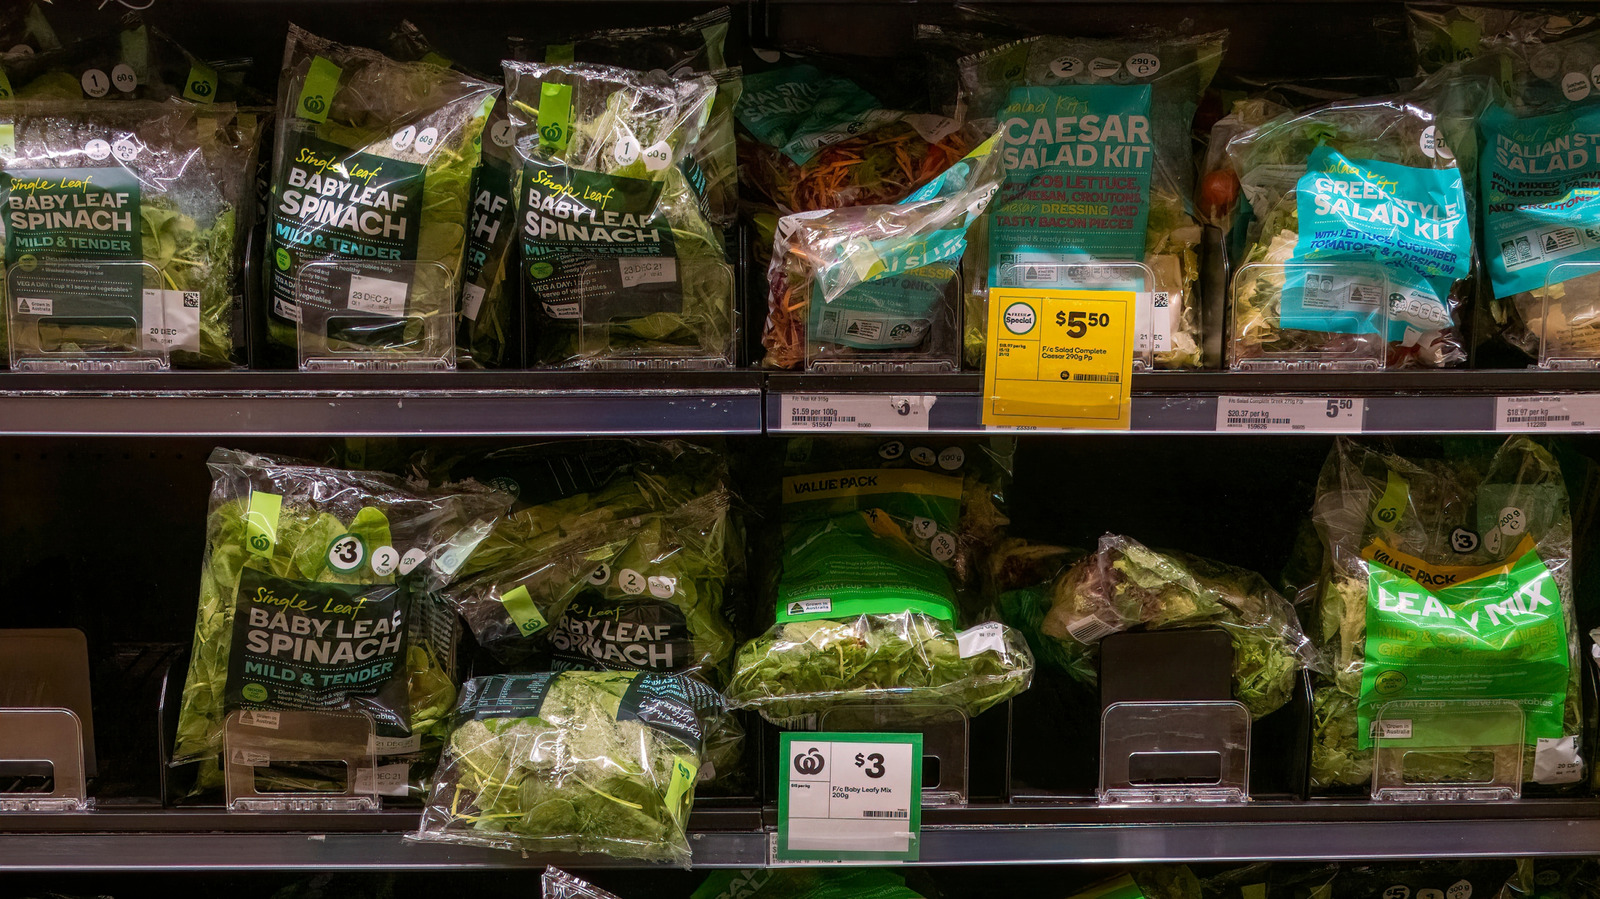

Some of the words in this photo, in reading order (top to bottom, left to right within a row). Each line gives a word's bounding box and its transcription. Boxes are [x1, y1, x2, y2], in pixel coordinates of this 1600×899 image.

[1061, 62, 1073, 72] 2
[1150, 59, 1157, 67] g
[91, 74, 98, 87] 1
[402, 130, 409, 141] 1
[503, 125, 509, 137] 1
[1003, 115, 1150, 145] CAESAR
[624, 142, 631, 155] 1
[1497, 133, 1570, 158] ITALIAN
[1003, 145, 1098, 170] SALAD
[1104, 145, 1150, 168] KIT
[1496, 147, 1589, 174] SALAD
[350, 163, 383, 185] Leaf
[1492, 171, 1515, 189] WITH
[1518, 181, 1561, 189] MIXED
[9, 177, 56, 197] Single
[60, 175, 92, 195] Leaf
[288, 167, 351, 198] BABY
[350, 185, 408, 212] LEAF
[532, 170, 581, 198] Single
[583, 184, 615, 210] Leaf
[1030, 175, 1063, 188] COS
[1066, 175, 1141, 192] LETTUCE,
[1490, 181, 1563, 197] TOMATOES,
[9, 195, 66, 210] BABY
[73, 193, 129, 208] LEAF
[1072, 191, 1144, 204] CROUTONS,
[279, 190, 408, 240] SPINACH
[528, 188, 590, 223] BABY
[590, 209, 655, 229] LEAF
[1041, 203, 1108, 216] DRESSING
[1110, 206, 1139, 216] AND
[1488, 203, 1515, 215] AND
[11, 210, 132, 231] SPINACH
[996, 216, 1037, 227] TASTY
[1038, 217, 1086, 228] BACON
[1089, 218, 1133, 229] PIECES
[1314, 194, 1409, 228] SALAD
[1414, 219, 1461, 240] KIT
[524, 211, 660, 243] SPINACH
[15, 236, 54, 248] MILD
[57, 236, 67, 248] &
[69, 238, 131, 251] TENDER
[275, 223, 312, 245] MILD
[313, 235, 327, 249] &
[330, 238, 402, 261] TENDER
[1001, 234, 1031, 242] Washed
[1040, 235, 1061, 244] ready
[1315, 230, 1338, 239] WITH
[1340, 228, 1395, 247] LETTUCE,
[1396, 239, 1457, 263] CUCUMBER
[525, 244, 568, 256] MILD
[585, 246, 661, 254] TENDER
[1380, 247, 1390, 257] &
[624, 265, 634, 275] 23
[634, 263, 652, 273] DEC
[653, 263, 663, 271] 21
[352, 291, 363, 299] 23
[363, 292, 382, 302] DEC
[383, 296, 393, 305] 21
[1006, 316, 1032, 324] Special
[1065, 353, 1083, 361] 290g
[1074, 347, 1107, 356] Complete
[810, 409, 821, 417] per
[823, 408, 838, 416] 100g
[1261, 410, 1270, 418] kg
[1540, 408, 1549, 416] kg
[793, 479, 838, 494] VALUE
[840, 476, 878, 489] PACK
[922, 520, 930, 530] 4
[1500, 513, 1513, 528] 200
[937, 535, 950, 550] 200
[334, 541, 358, 564] $3
[381, 553, 390, 566] 2
[627, 573, 637, 586] 2
[1416, 570, 1457, 585] PACK
[253, 587, 317, 611] Single
[323, 598, 367, 621] Leaf
[1377, 586, 1479, 632] LEAY
[1484, 581, 1553, 627] MIX
[587, 606, 625, 622] Leaf
[249, 607, 330, 638] BABY
[336, 609, 402, 640] LEAF
[560, 615, 600, 637] ABY
[602, 620, 671, 642] LEAF
[246, 630, 402, 665] SPINACH
[552, 629, 674, 668] SPINACH
[244, 661, 296, 682] MILD
[300, 674, 315, 687] &
[320, 661, 394, 687] TENDER
[278, 689, 294, 697] Diets
[854, 752, 886, 778] $3
[861, 786, 879, 794] Leafy
